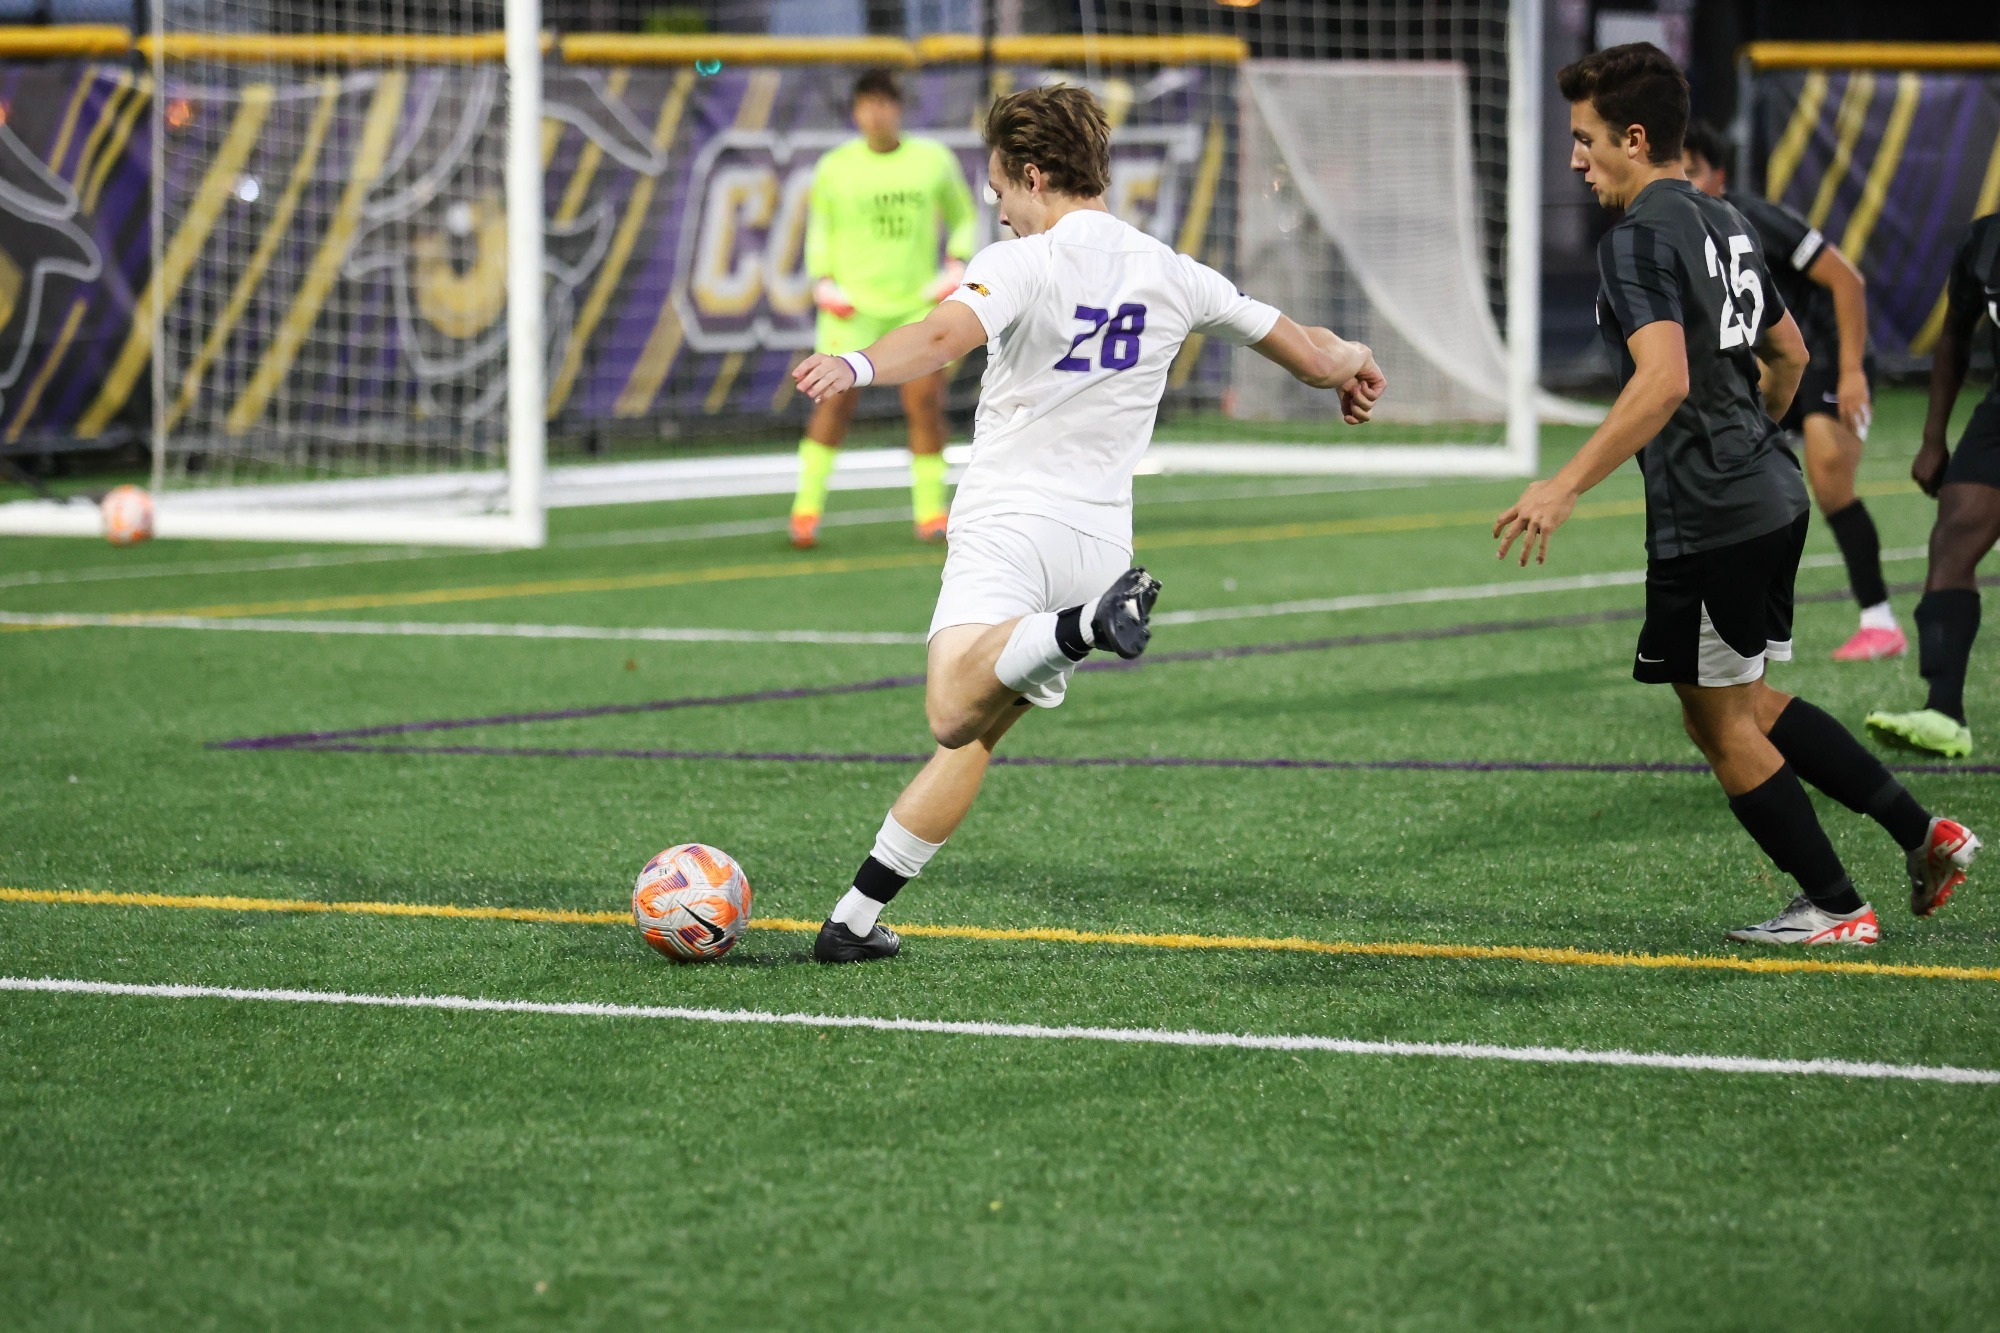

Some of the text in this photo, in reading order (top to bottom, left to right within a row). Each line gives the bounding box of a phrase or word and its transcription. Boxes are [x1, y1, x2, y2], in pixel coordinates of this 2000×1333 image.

[1705, 234, 1764, 349] 25
[1053, 303, 1147, 372] 28
[1811, 921, 1879, 945] AIR
